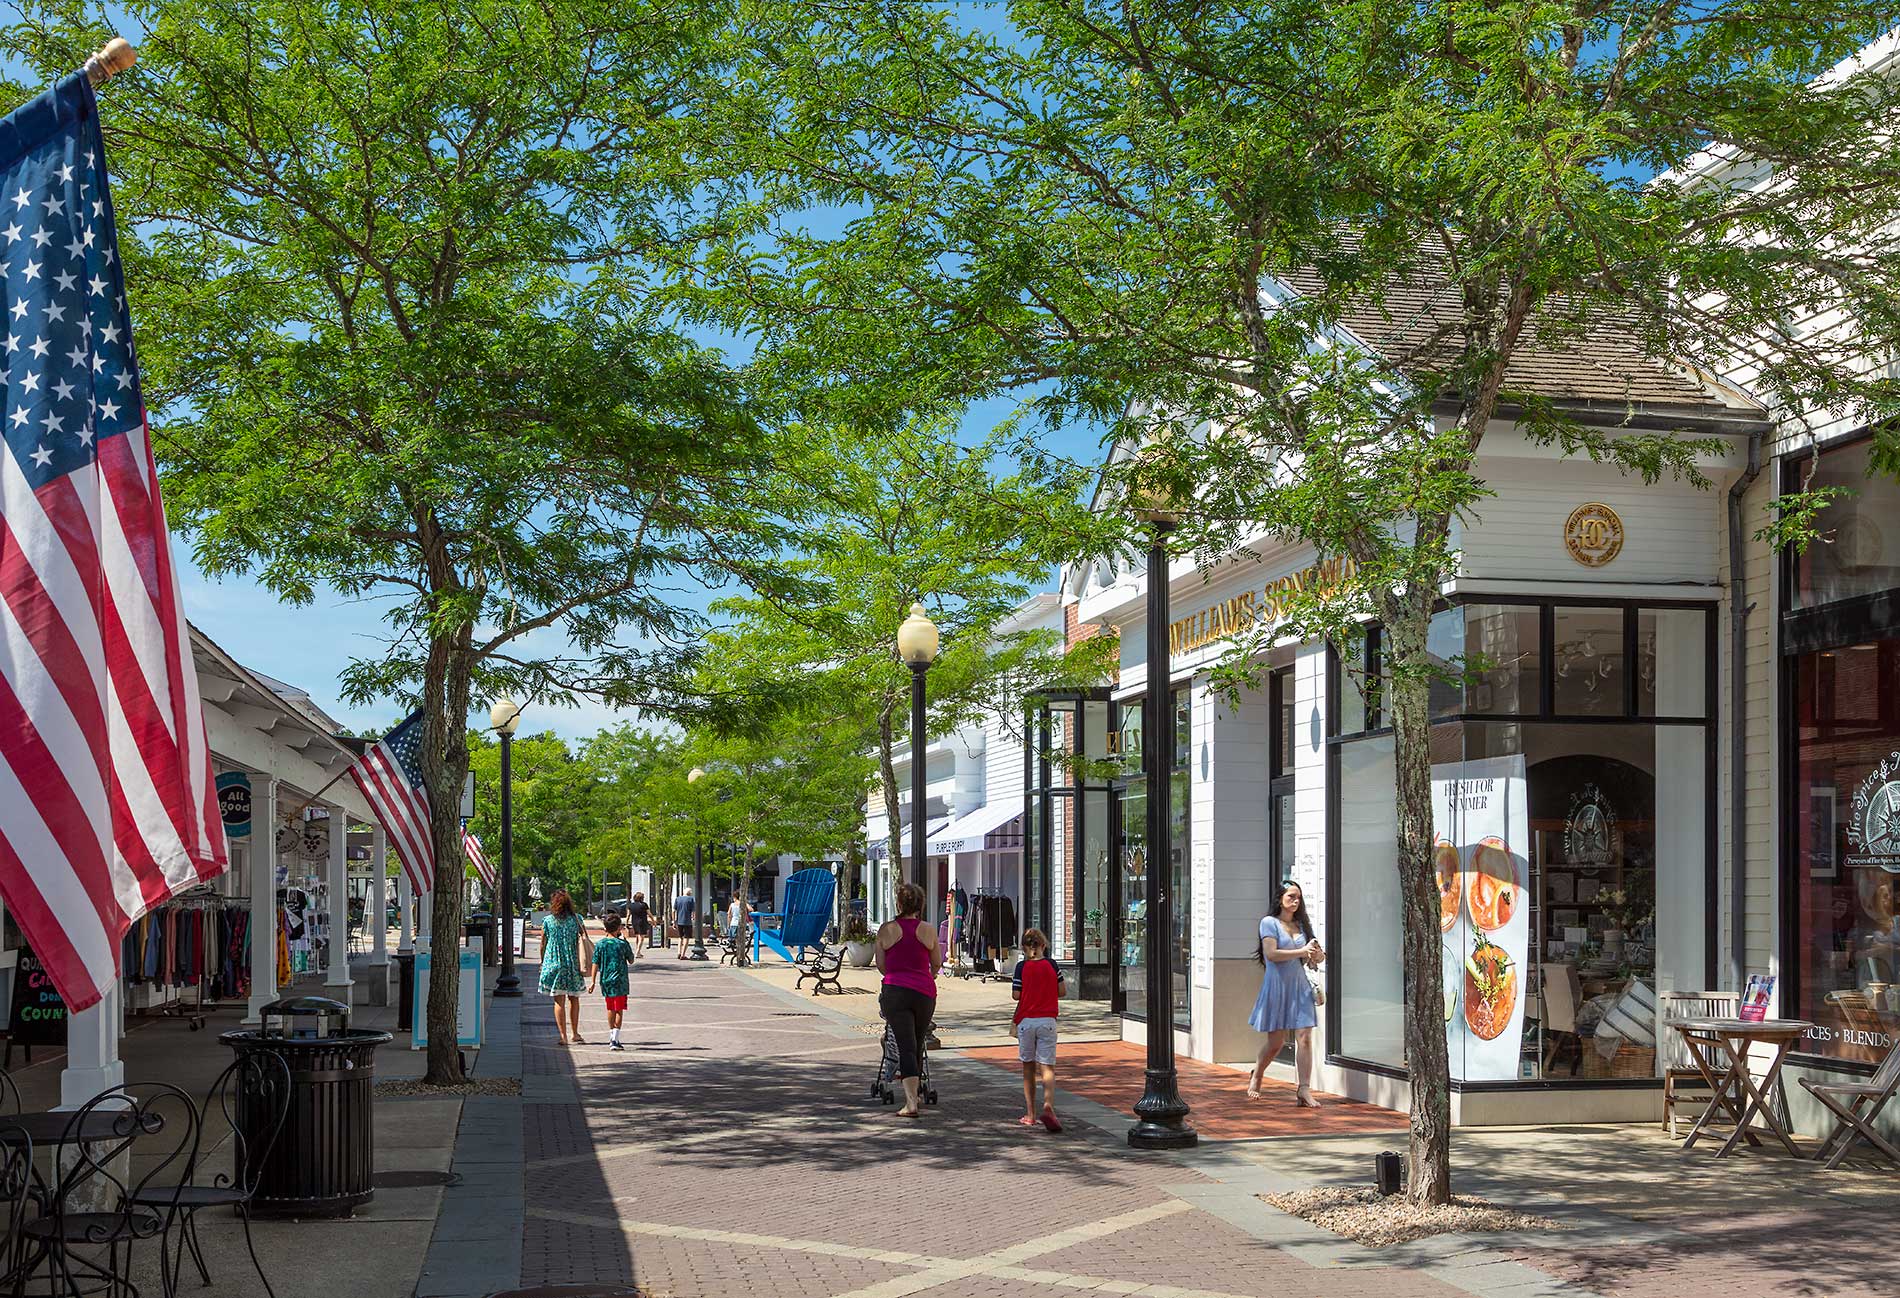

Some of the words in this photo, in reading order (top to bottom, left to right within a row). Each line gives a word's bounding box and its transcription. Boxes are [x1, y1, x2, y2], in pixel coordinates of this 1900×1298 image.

[1444, 780, 1473, 796] FRESH
[1475, 778, 1494, 794] FOR
[227, 791, 245, 801] All
[1449, 796, 1487, 812] SUMMER
[220, 801, 251, 817] good
[935, 842, 951, 853] PURPLE
[951, 840, 965, 852] POPPY
[21, 1006, 67, 1022] COUN
[1801, 1025, 1832, 1041] ICES
[1843, 1028, 1890, 1048] BLENDS
